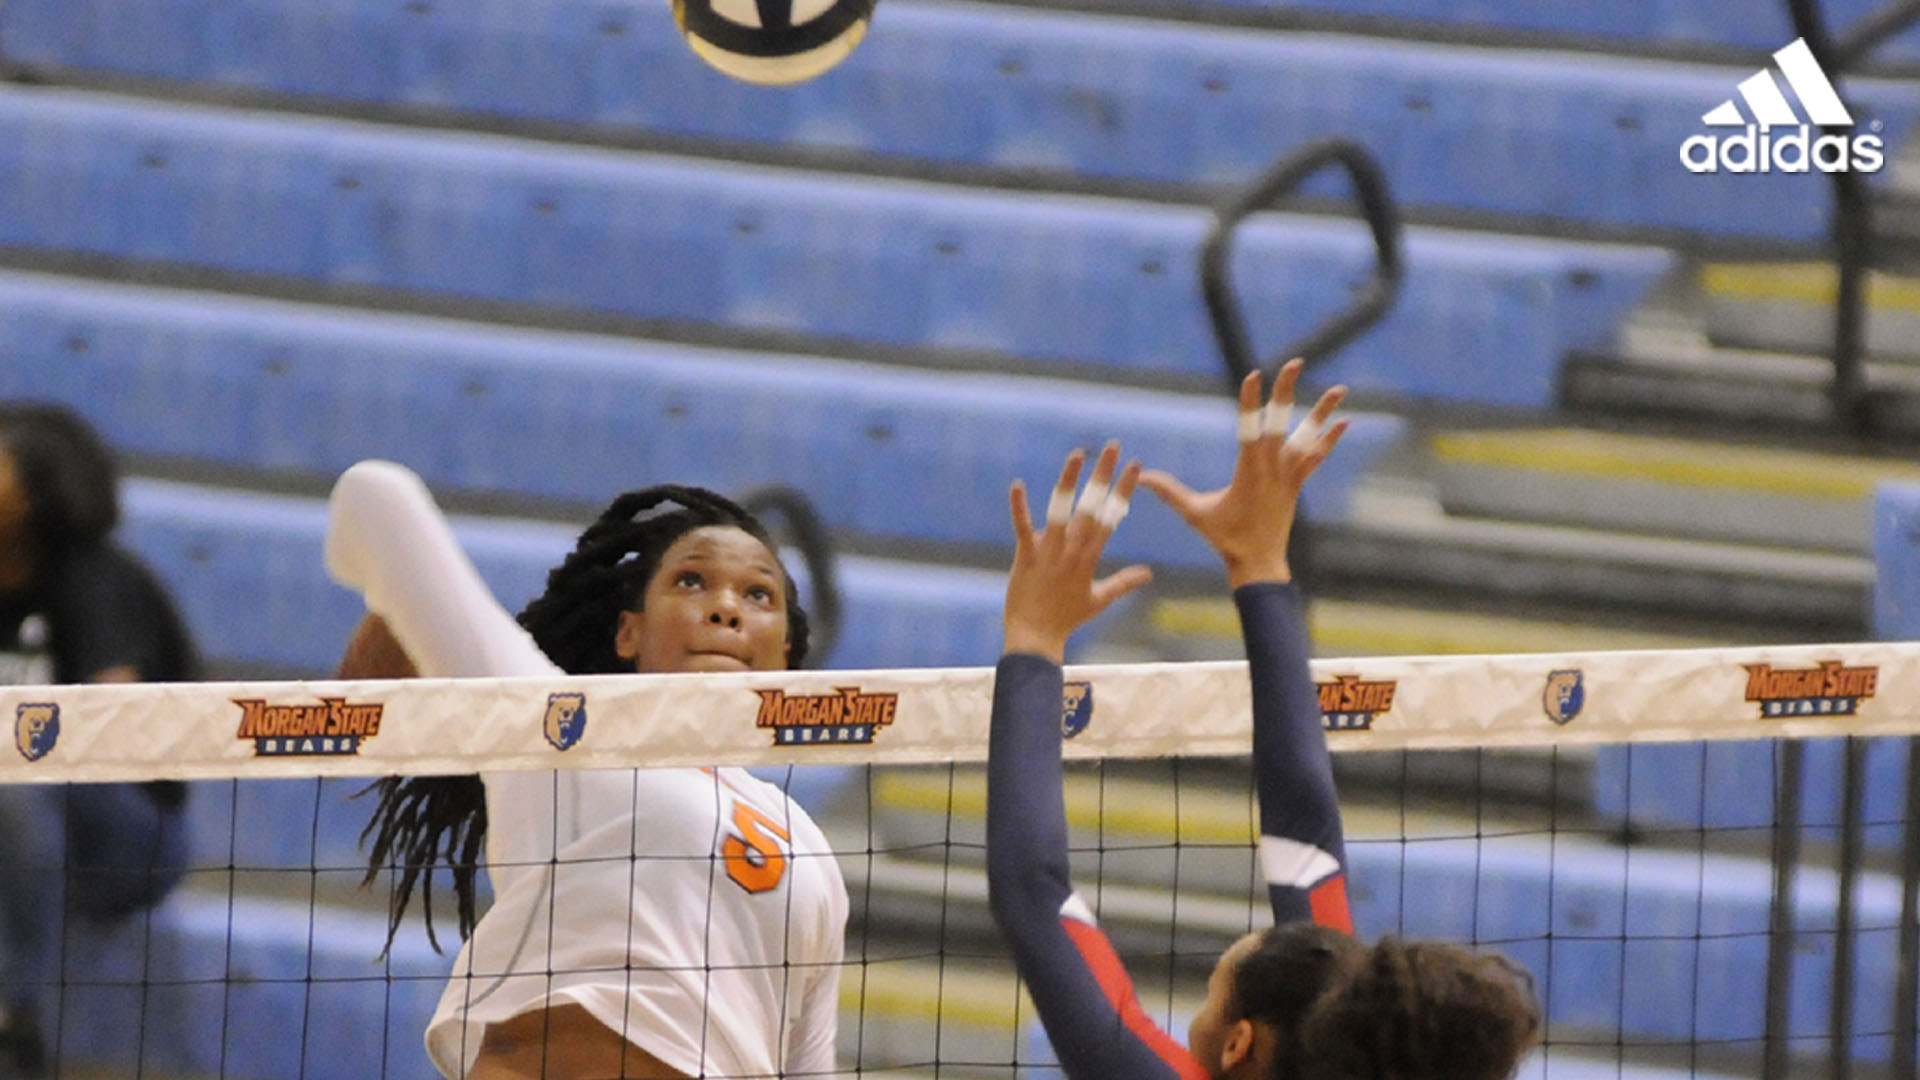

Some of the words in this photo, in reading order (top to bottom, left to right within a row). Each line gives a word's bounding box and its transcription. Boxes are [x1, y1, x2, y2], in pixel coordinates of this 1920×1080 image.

[234, 699, 328, 738] MORGAN
[319, 698, 383, 735] STATE
[755, 688, 845, 727] MORGAN
[834, 687, 897, 724] STATE
[1770, 700, 1849, 715] BEARS
[265, 739, 351, 752] BEARS
[784, 727, 865, 742] BEARS
[721, 800, 792, 894] 5
